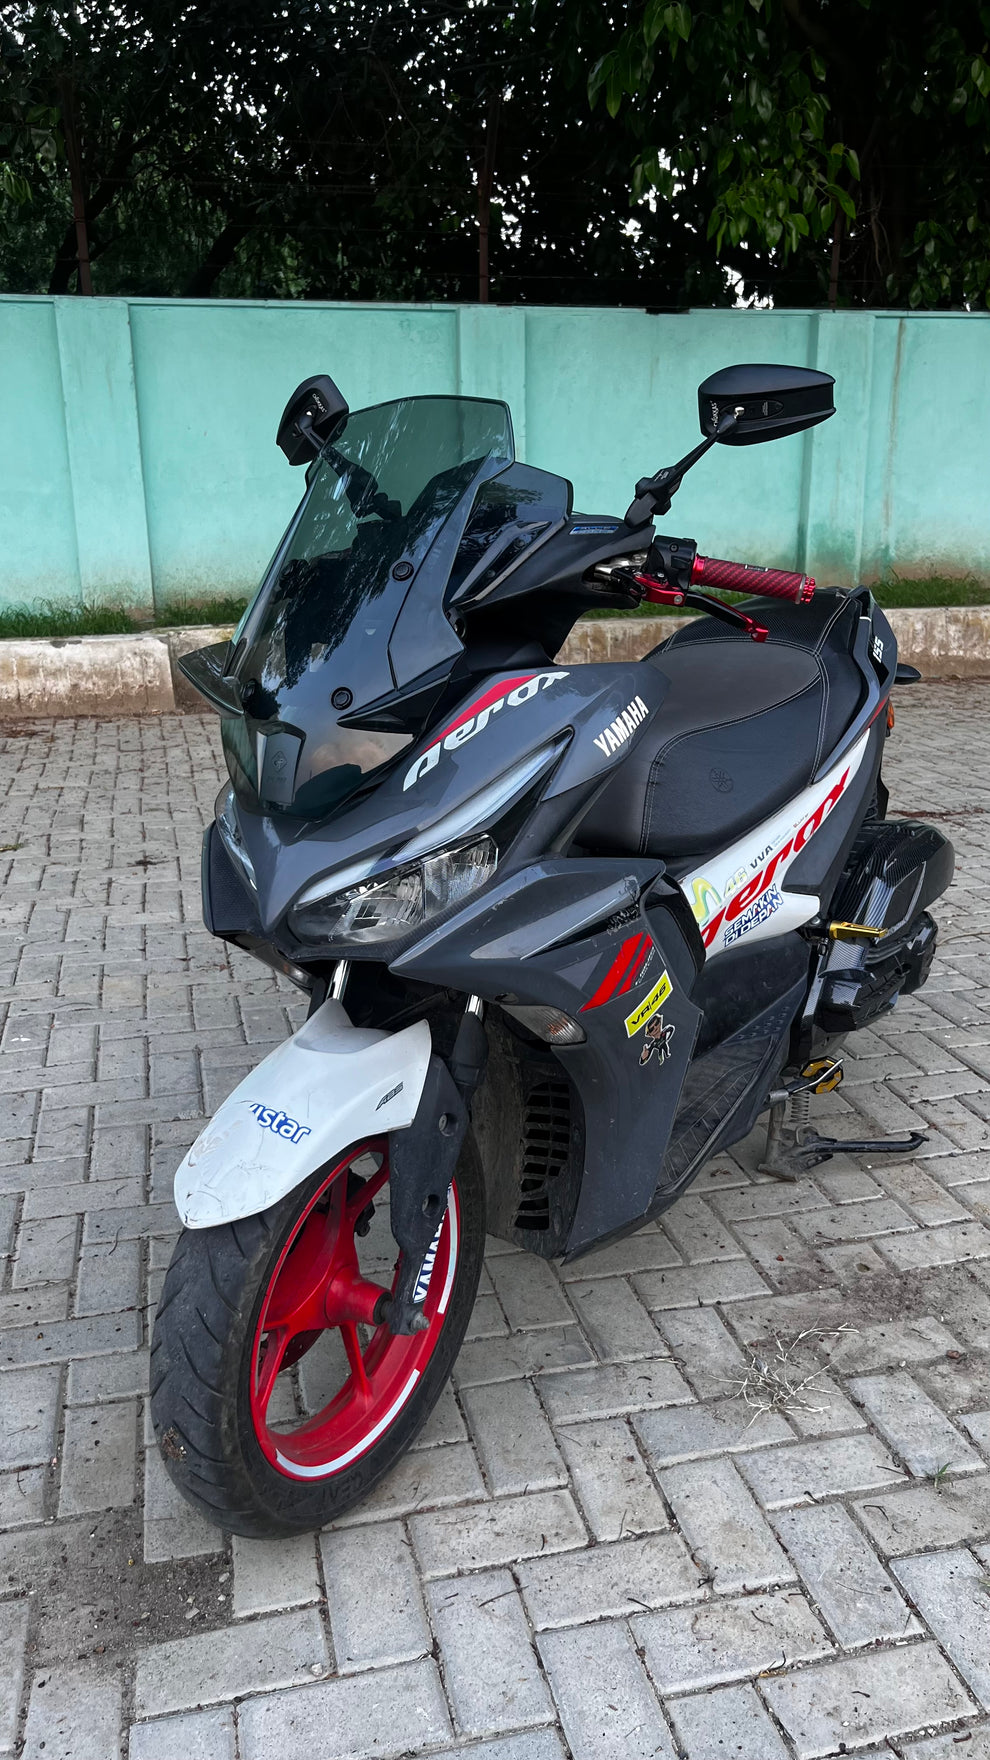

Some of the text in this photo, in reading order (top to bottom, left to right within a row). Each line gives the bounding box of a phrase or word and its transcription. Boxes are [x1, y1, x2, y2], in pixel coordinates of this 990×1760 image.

[872, 635, 884, 664] 155
[593, 695, 649, 757] YAMAHA
[749, 844, 774, 869] VVA
[723, 866, 748, 899] 46
[723, 882, 778, 937] SEMAKIN
[723, 892, 784, 948] DI DEPAN
